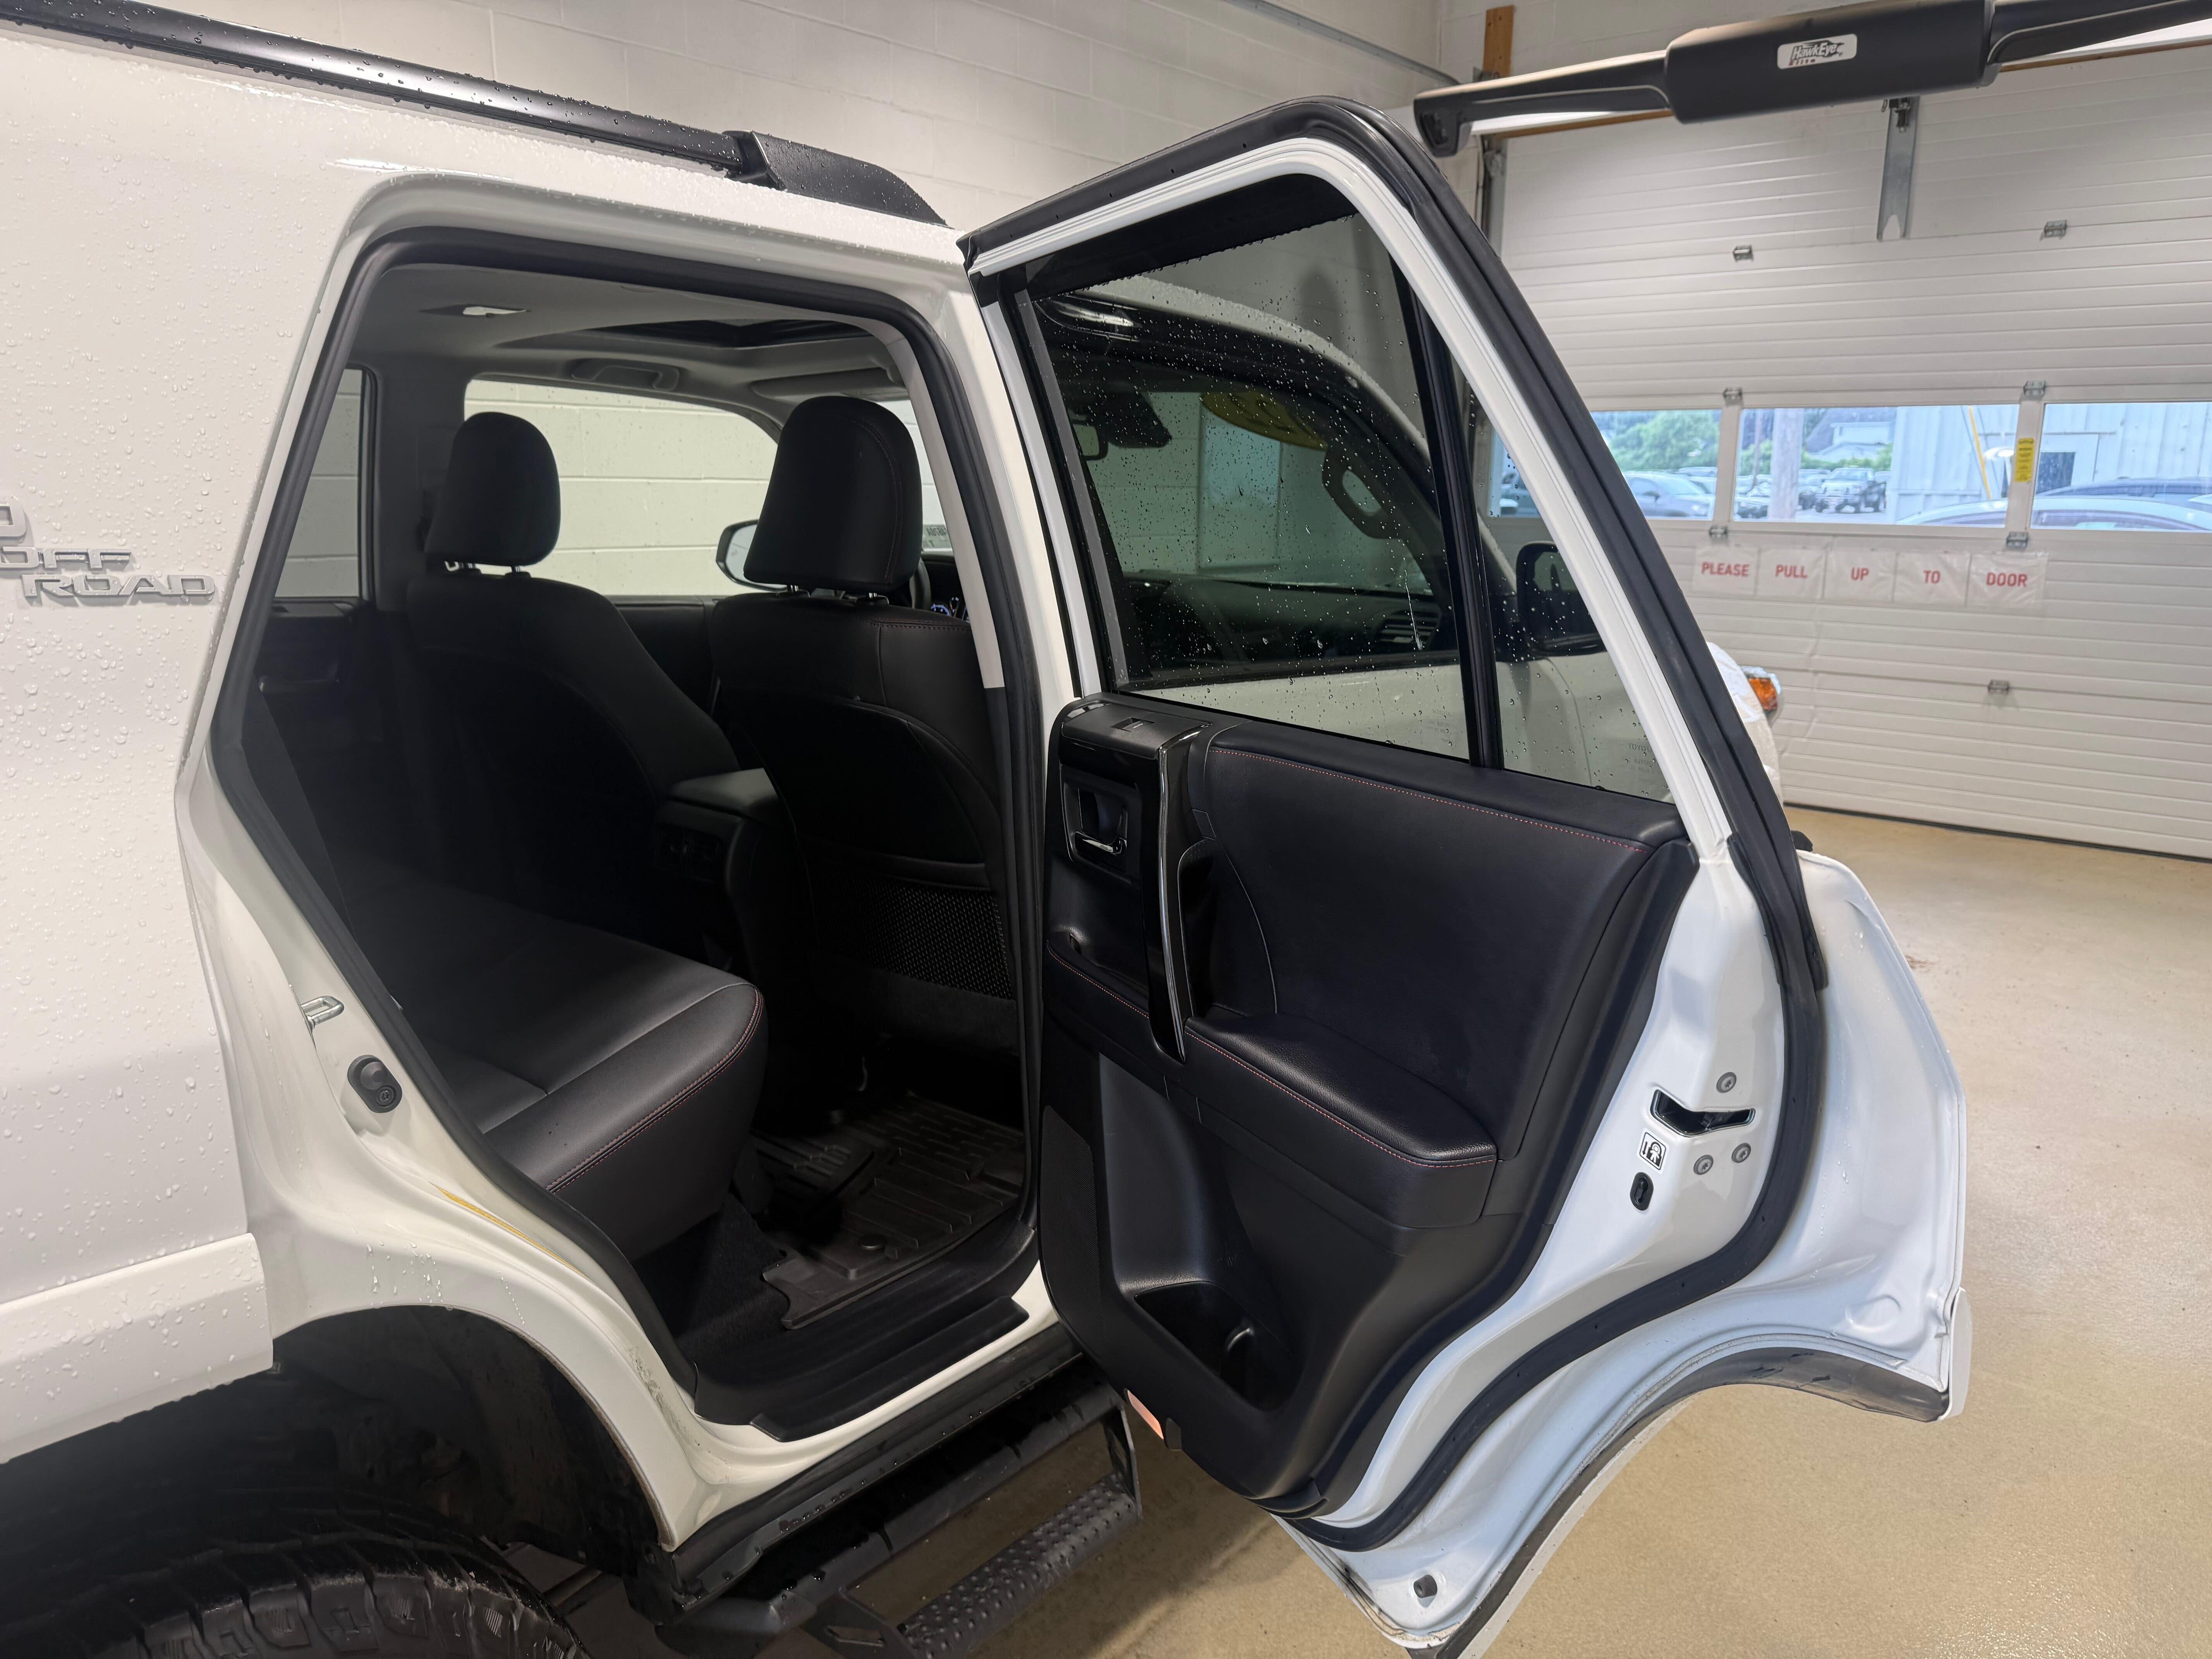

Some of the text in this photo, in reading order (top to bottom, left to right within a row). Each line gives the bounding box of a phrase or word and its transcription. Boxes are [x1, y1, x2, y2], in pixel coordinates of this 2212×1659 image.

[1791, 41, 1838, 60] HawkEye
[0, 546, 132, 568] OFF
[22, 574, 216, 597] ROAD
[1701, 562, 2028, 588] PLEASE PULL UP TO DOOR
